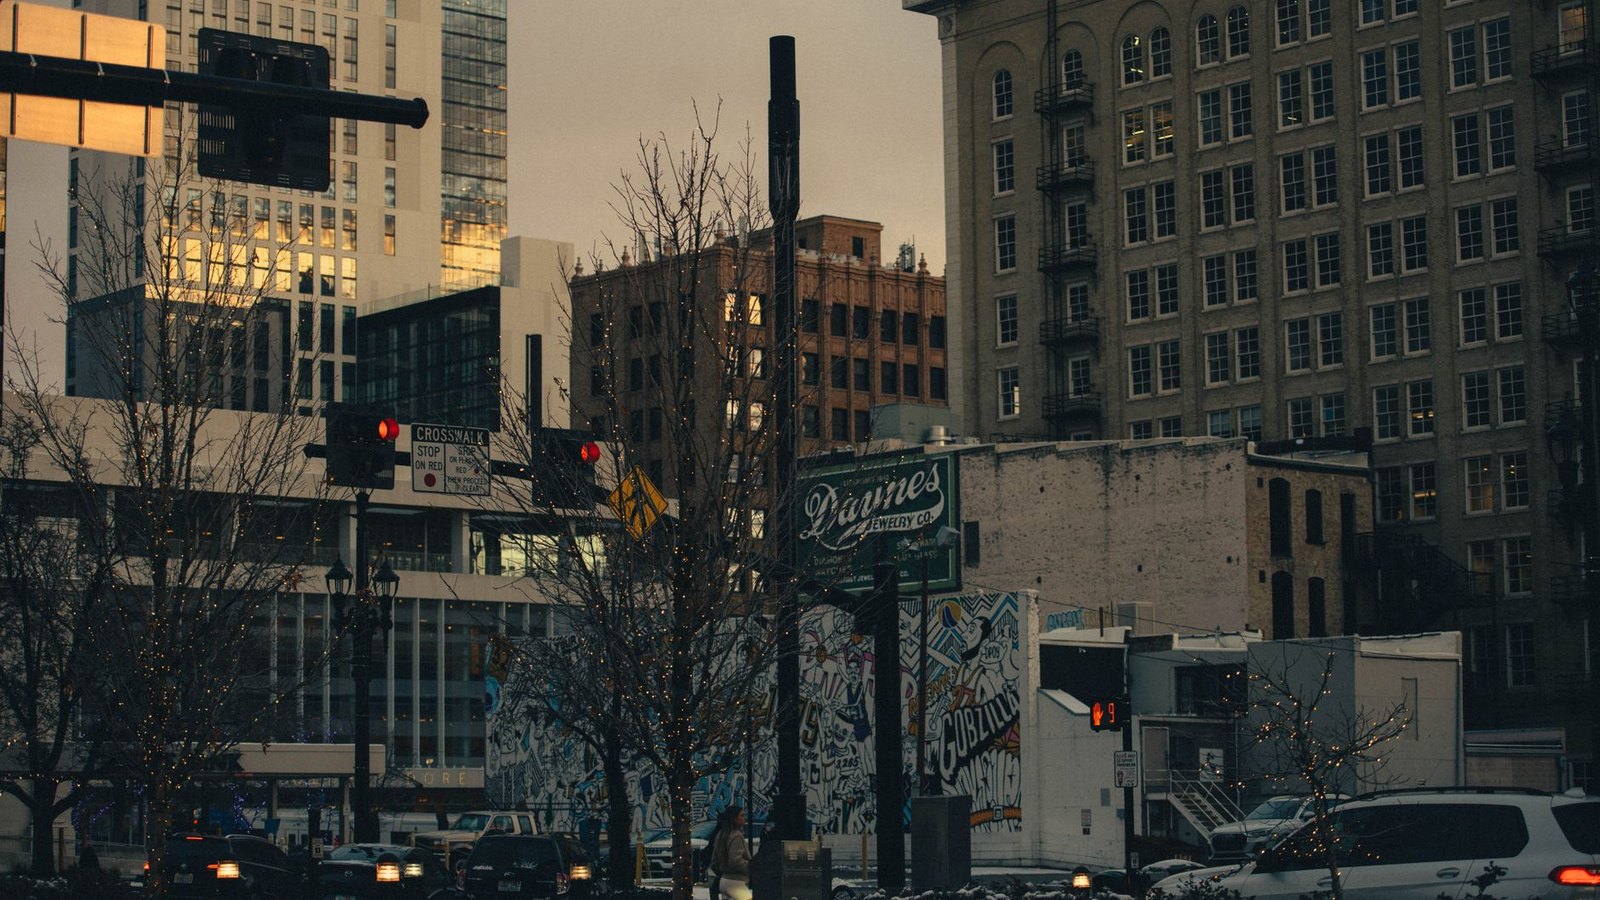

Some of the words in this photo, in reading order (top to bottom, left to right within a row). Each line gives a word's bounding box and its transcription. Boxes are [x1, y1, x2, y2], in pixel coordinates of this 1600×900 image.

[416, 427, 484, 444] CROSSWALK
[417, 445, 440, 457] STOP
[458, 446, 476, 456] STOP
[415, 459, 426, 470] ON
[428, 461, 443, 471] RED
[449, 456, 457, 464] ON
[455, 466, 467, 474] RED
[800, 463, 940, 541] Daynes
[866, 515, 914, 532] JEWELRY
[1107, 702, 1115, 723] 9
